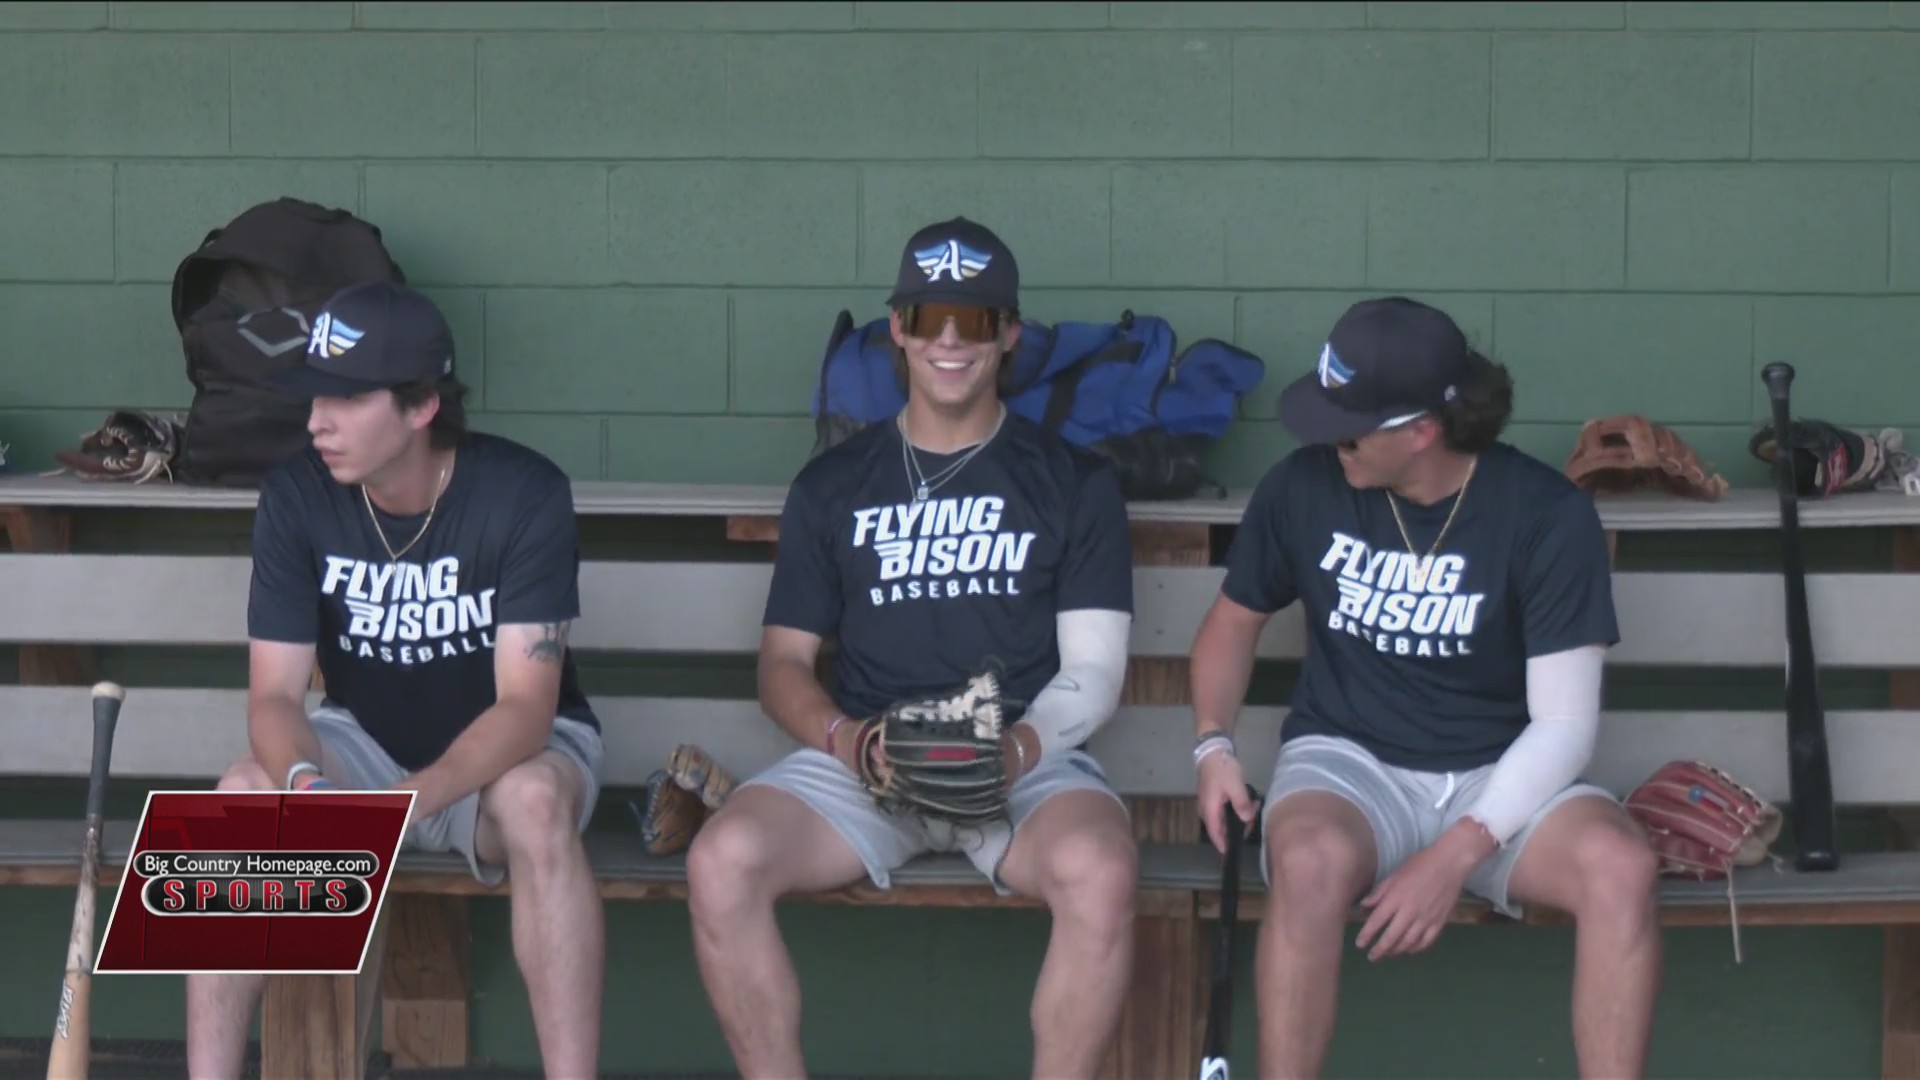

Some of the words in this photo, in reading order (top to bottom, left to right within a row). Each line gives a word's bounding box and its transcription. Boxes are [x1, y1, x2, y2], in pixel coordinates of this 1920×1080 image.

[928, 239, 963, 282] A
[854, 496, 1004, 546] FLYING
[322, 556, 459, 602] FLYING
[873, 533, 1037, 580] BISON
[1320, 532, 1465, 593] FLYING
[344, 589, 495, 642] BISON
[870, 578, 1020, 606] BASEBALL
[1336, 578, 1486, 634] BISON
